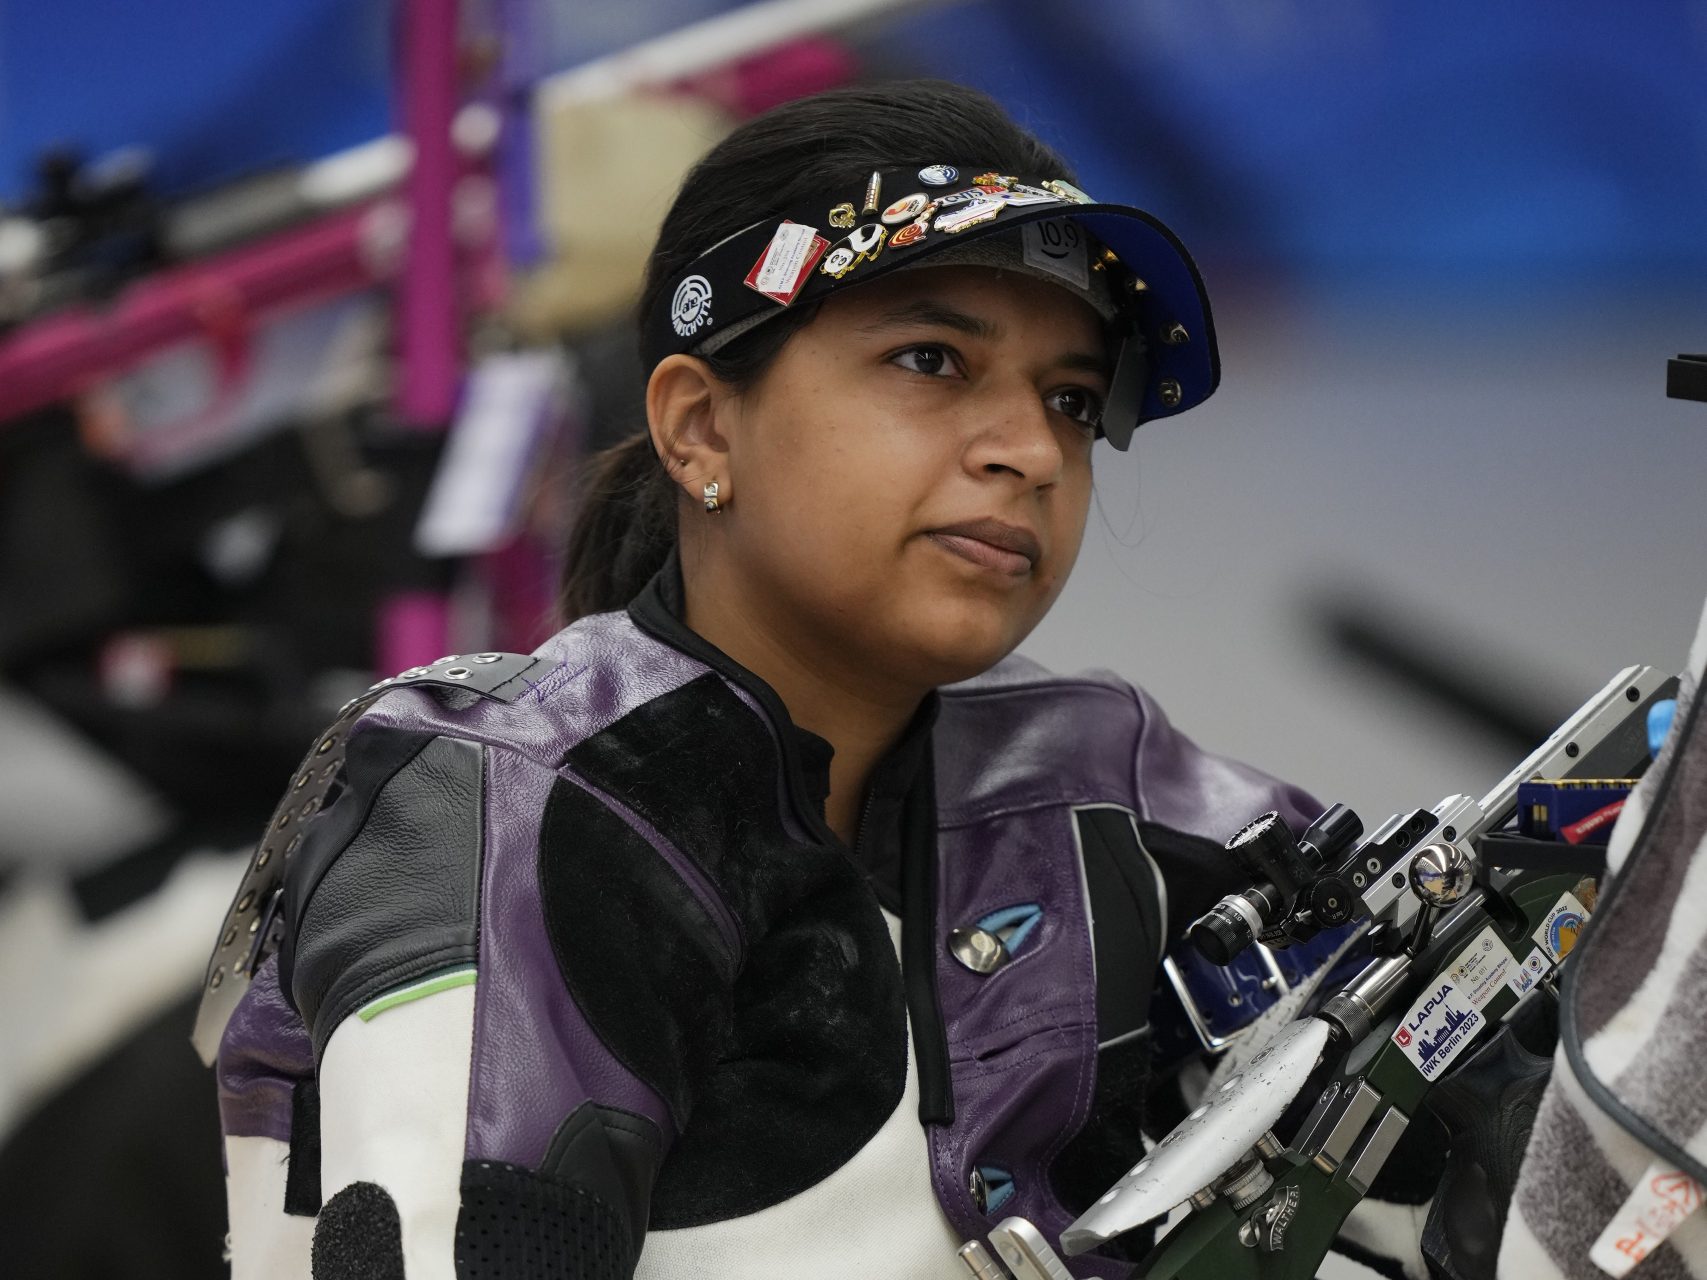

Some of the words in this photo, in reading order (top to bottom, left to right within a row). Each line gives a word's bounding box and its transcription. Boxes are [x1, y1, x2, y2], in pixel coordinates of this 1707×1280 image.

[1037, 220, 1080, 249] 10.9
[1547, 912, 1556, 924] CUP
[1408, 984, 1454, 1032] LAPUA
[1472, 985, 1491, 1006] Weapon
[1489, 968, 1507, 988] Control
[1421, 1056, 1441, 1077] IWK
[1438, 1033, 1462, 1059] Berlin
[1459, 1013, 1479, 1036] 2023
[1272, 1190, 1299, 1246] WALTHER
